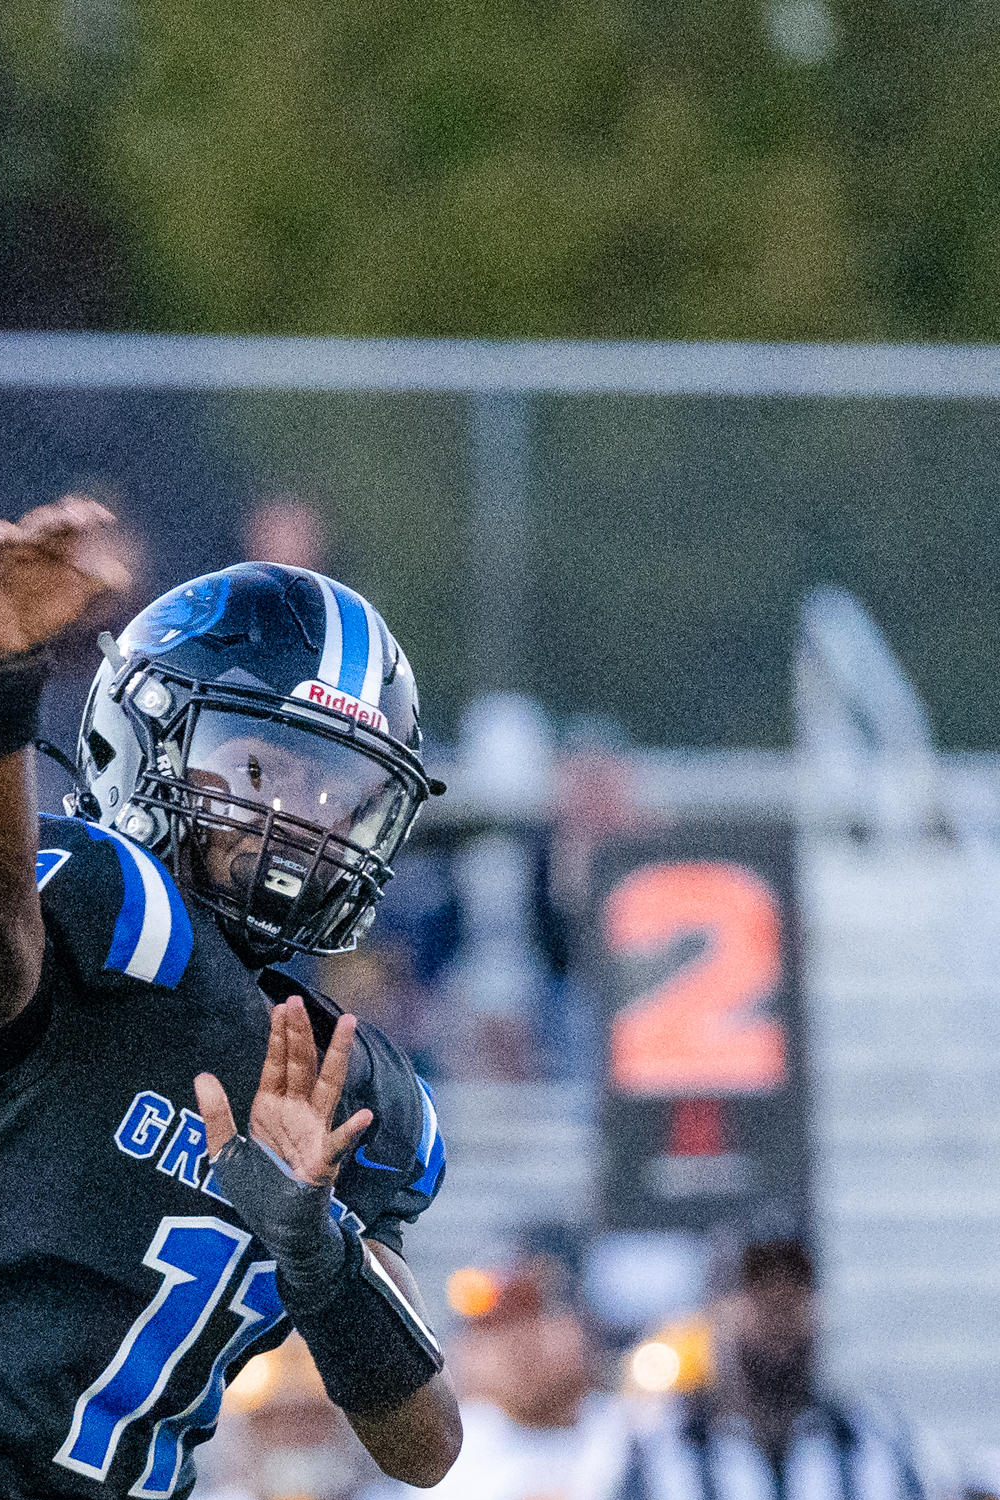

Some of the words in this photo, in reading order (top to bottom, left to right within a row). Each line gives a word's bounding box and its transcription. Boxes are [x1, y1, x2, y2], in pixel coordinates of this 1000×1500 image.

[308, 684, 382, 729] Riddell
[605, 861, 787, 1096] 2
[52, 1216, 288, 1500] 11
